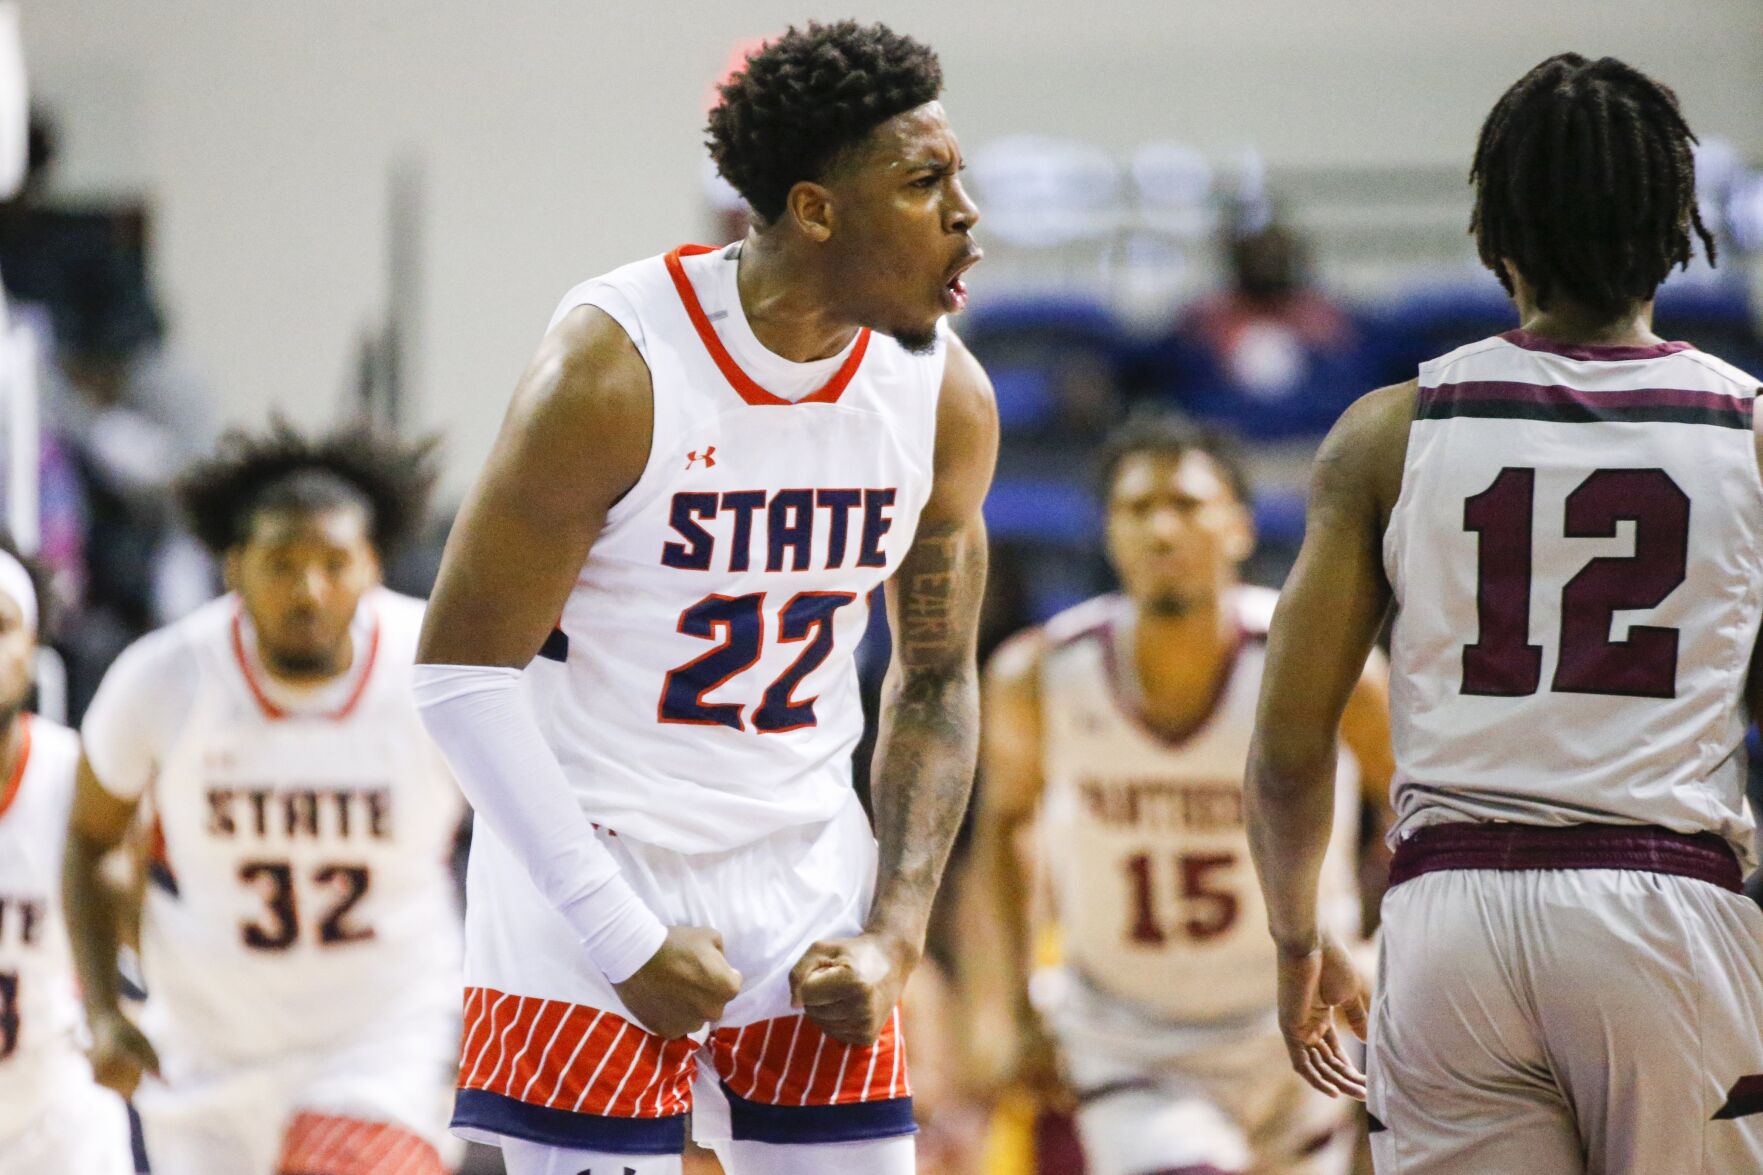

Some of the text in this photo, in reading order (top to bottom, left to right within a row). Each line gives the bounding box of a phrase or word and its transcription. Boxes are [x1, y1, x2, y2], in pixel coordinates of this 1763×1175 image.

[660, 487, 897, 573] STATE
[1459, 467, 1691, 699] 12
[657, 591, 857, 735] 22
[205, 784, 393, 840] STATE
[237, 860, 376, 951] 32
[1124, 853, 1240, 947] 15
